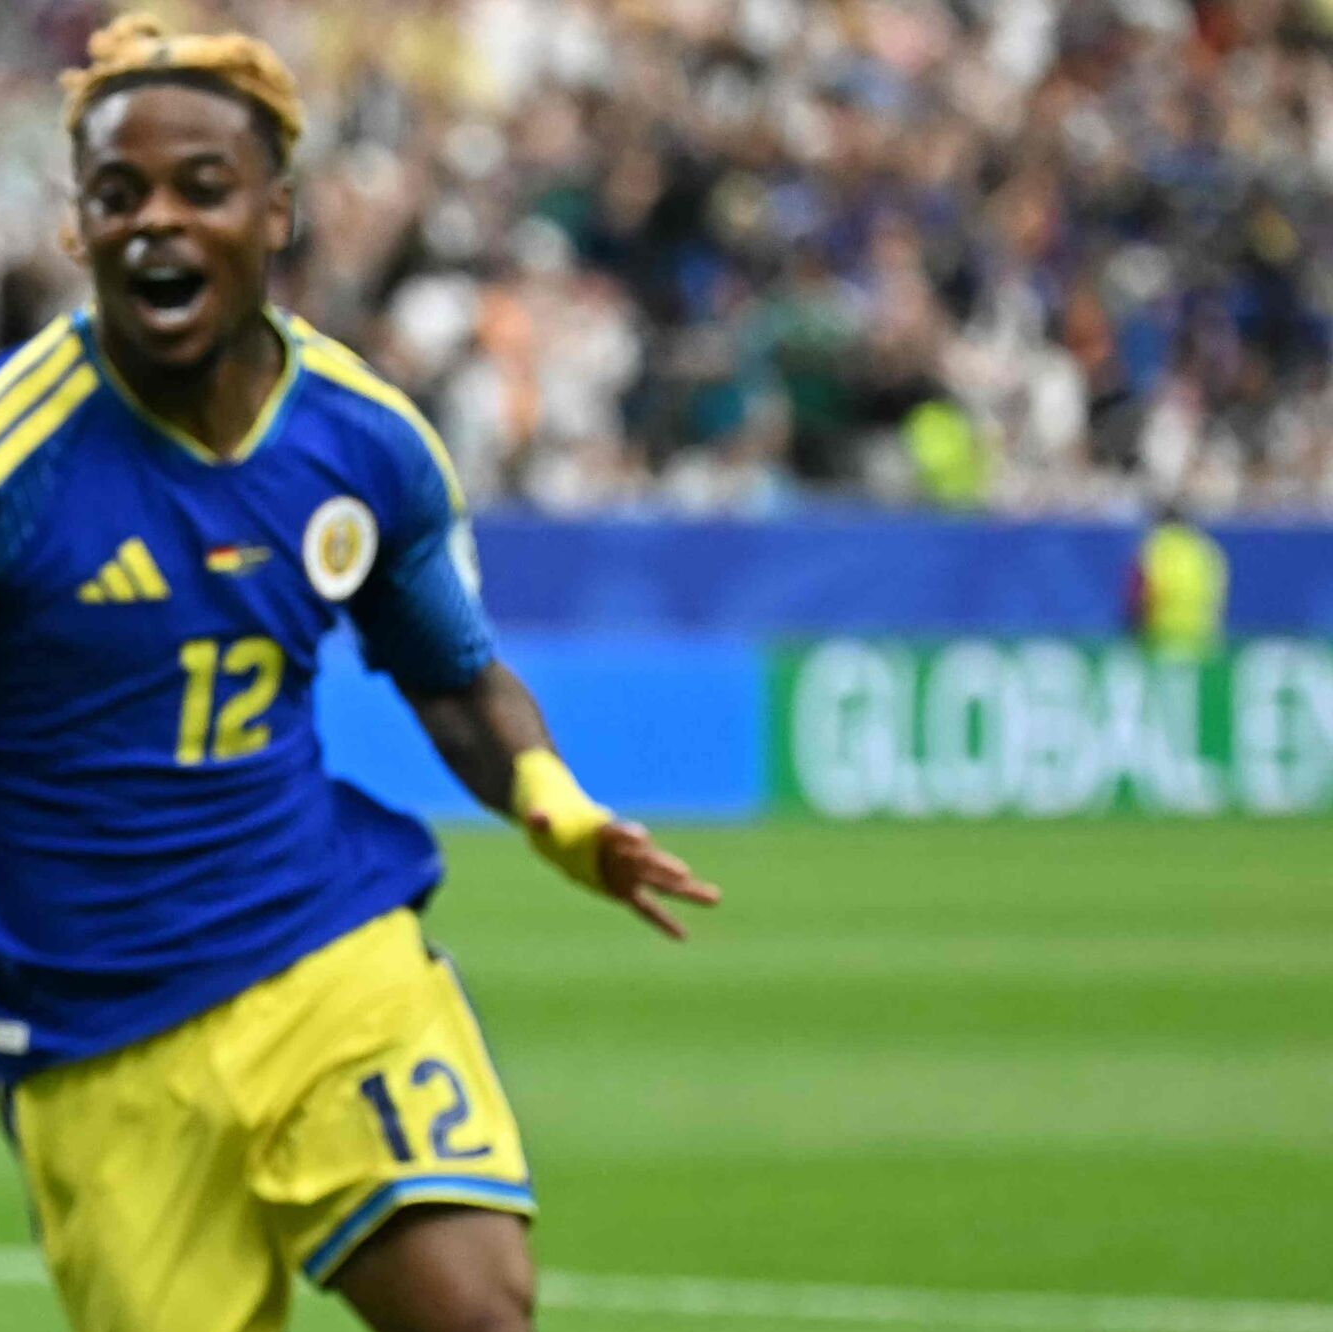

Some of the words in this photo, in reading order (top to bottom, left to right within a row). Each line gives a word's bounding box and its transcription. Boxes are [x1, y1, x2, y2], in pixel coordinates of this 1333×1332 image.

[176, 636, 284, 766] 12
[793, 637, 1226, 818] GLOBAL
[360, 1058, 493, 1164] 12
